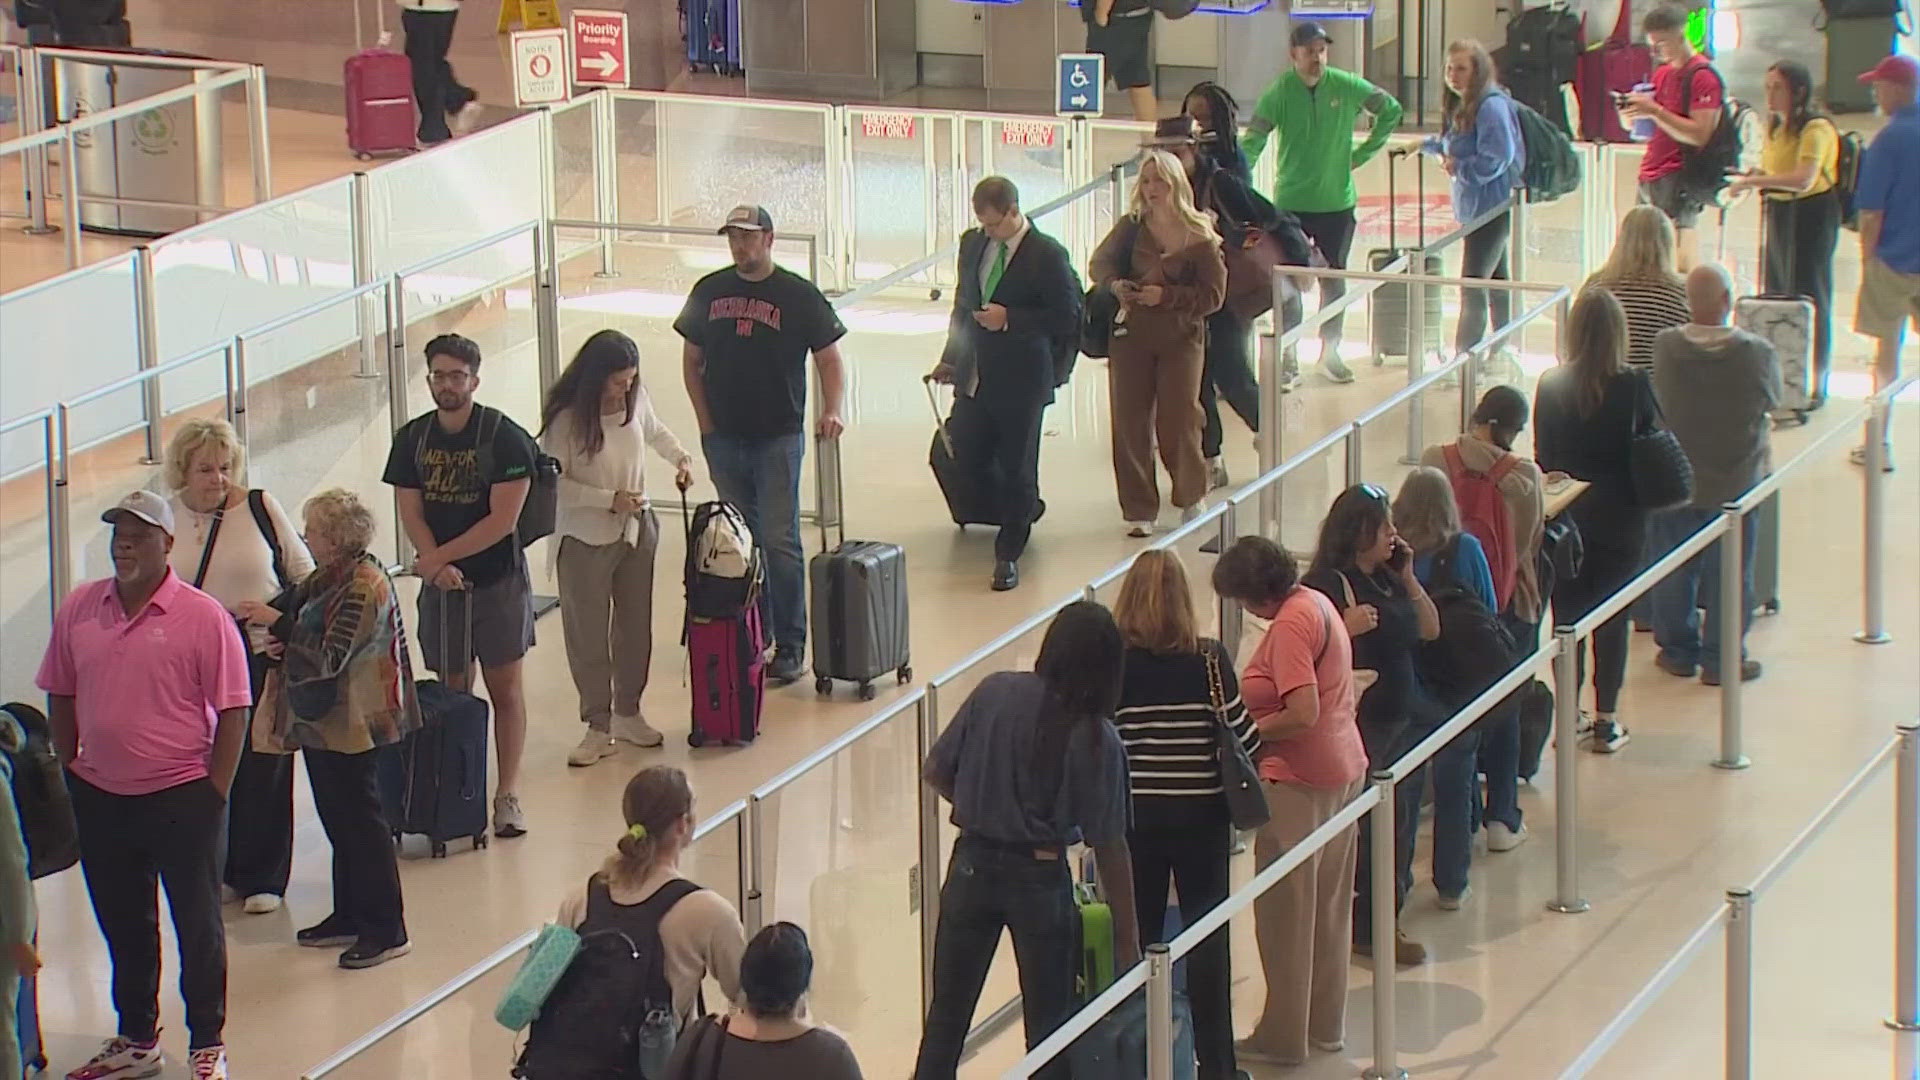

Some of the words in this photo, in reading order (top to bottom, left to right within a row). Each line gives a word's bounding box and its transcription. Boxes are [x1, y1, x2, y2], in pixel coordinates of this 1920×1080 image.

[577, 22, 621, 36] Priority
[583, 36, 617, 46] Boarding
[862, 112, 913, 127] EMERGENCY
[866, 124, 885, 136] EXIT
[886, 125, 910, 138] ONLY
[1003, 120, 1054, 135] EMERGENCY
[1006, 131, 1025, 144] EXIT
[1026, 132, 1050, 146] ONLY
[709, 296, 781, 331] NEBRASKA
